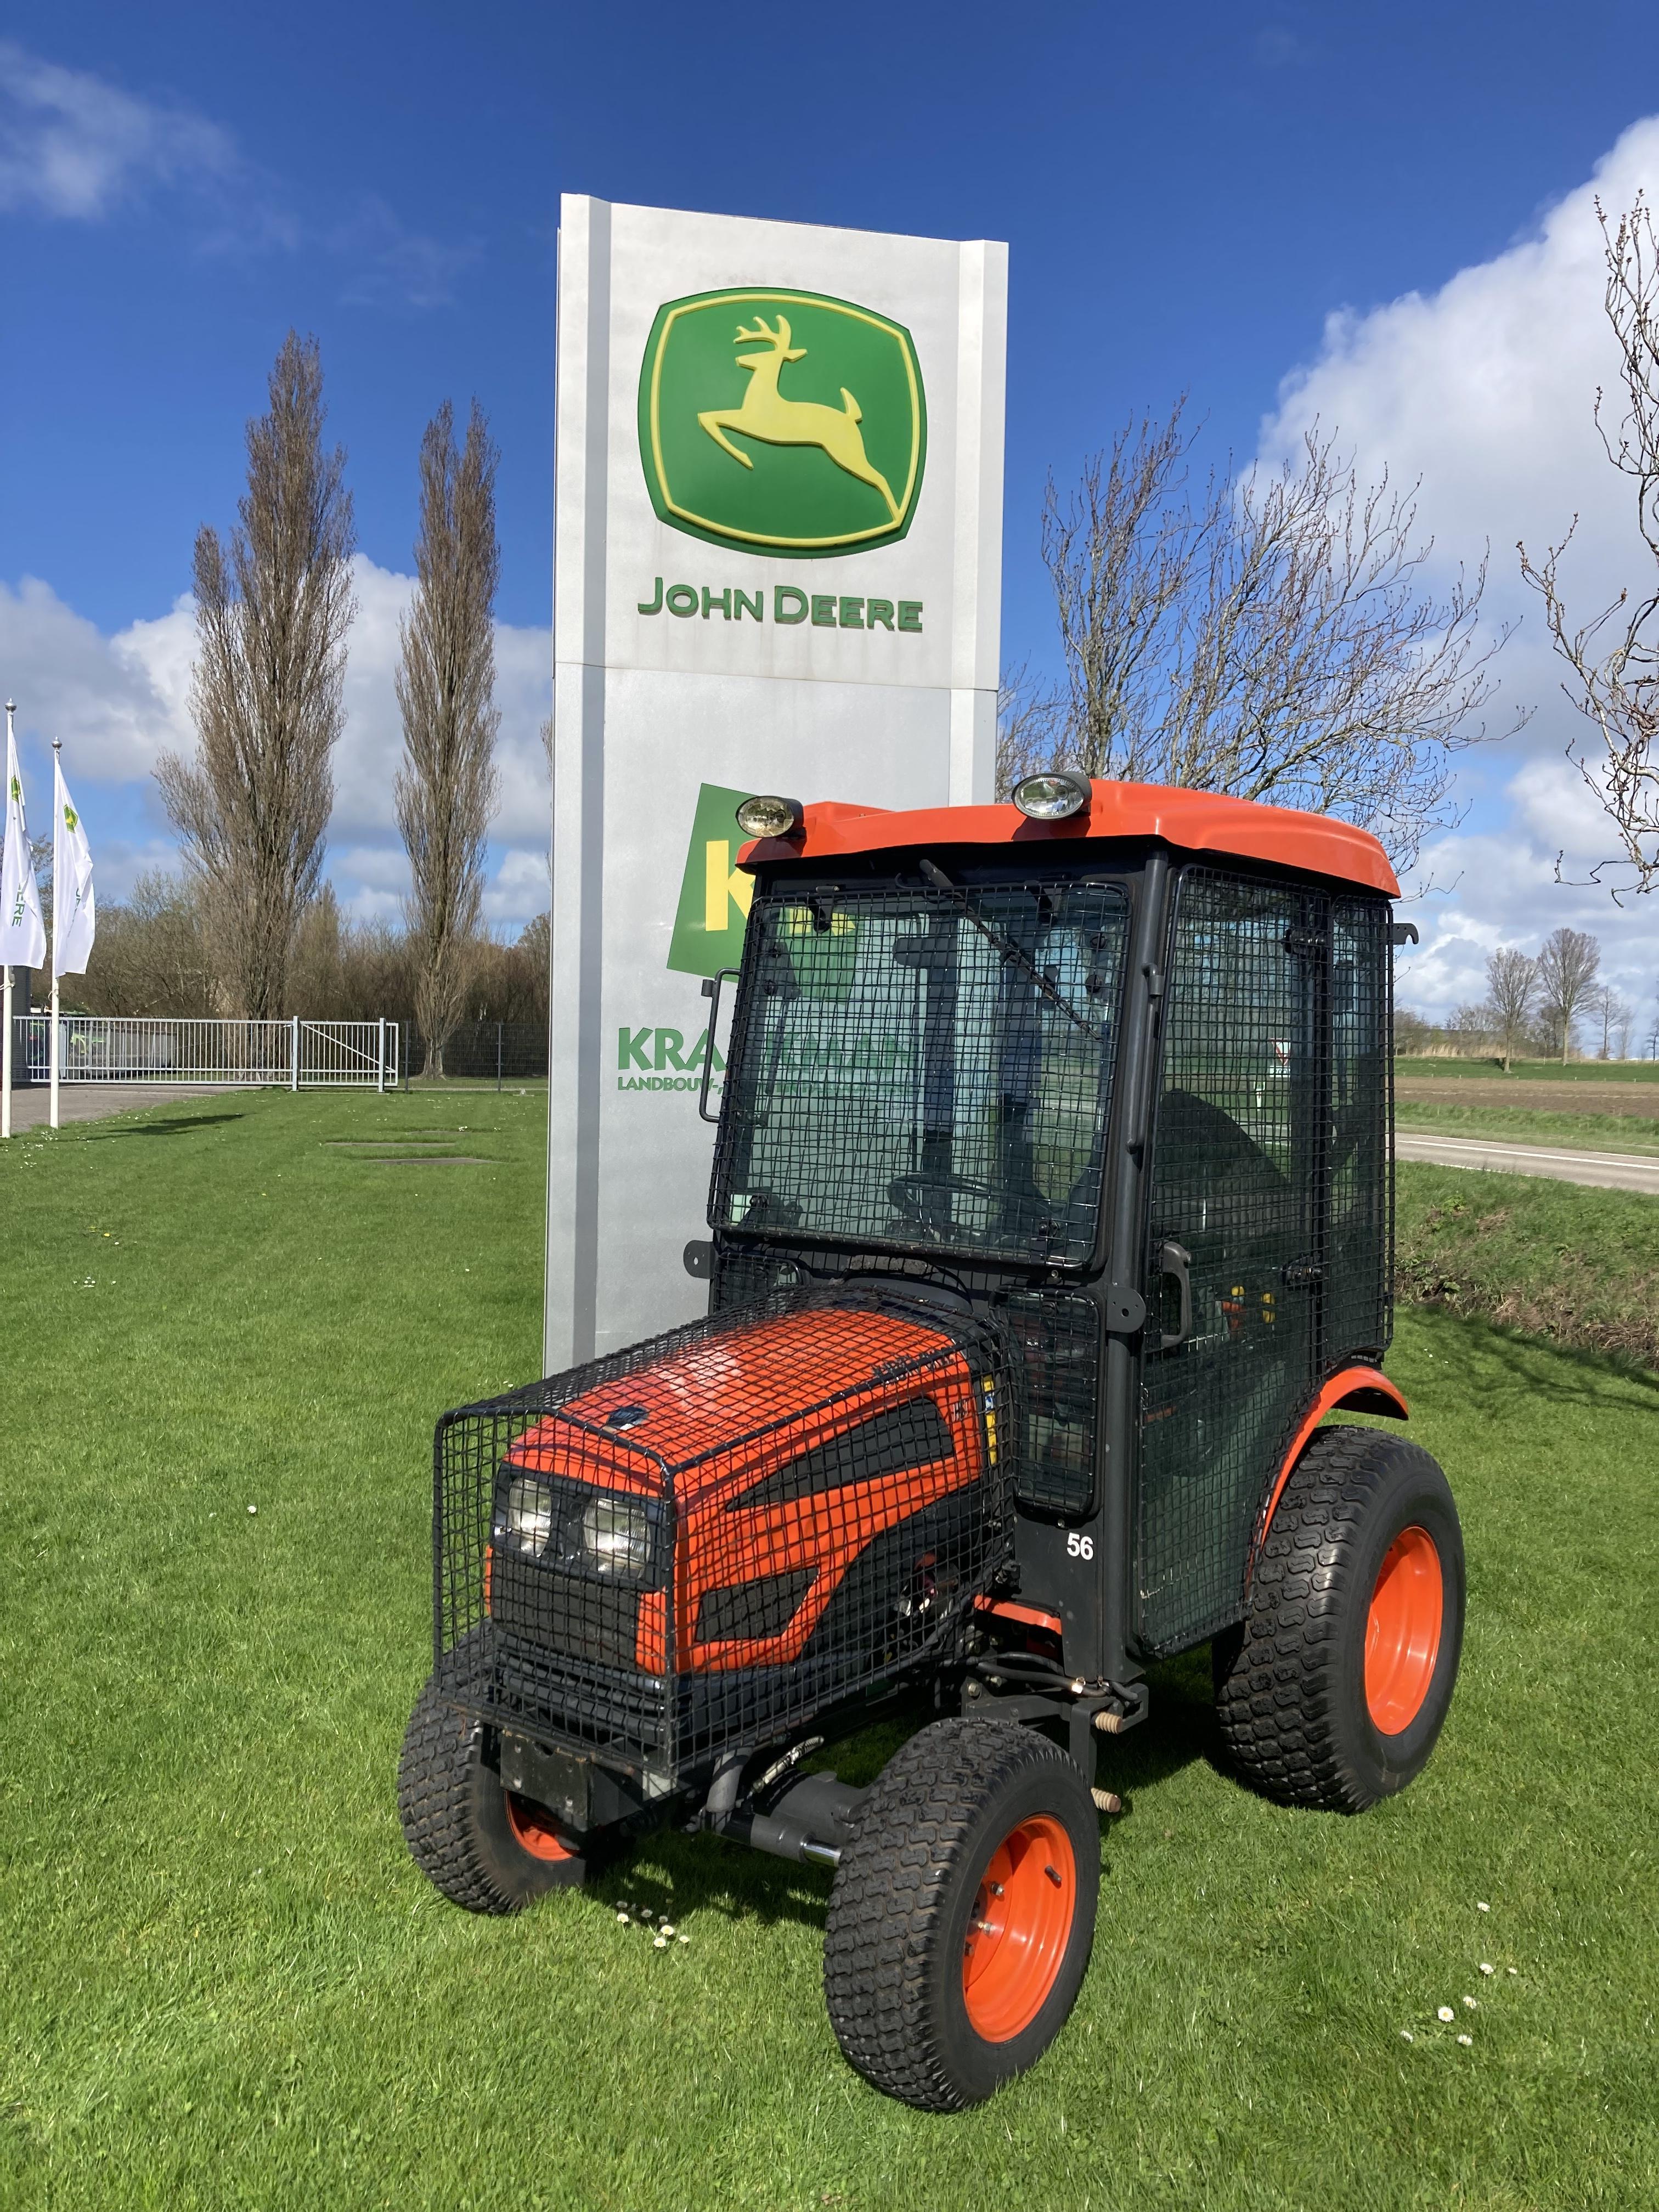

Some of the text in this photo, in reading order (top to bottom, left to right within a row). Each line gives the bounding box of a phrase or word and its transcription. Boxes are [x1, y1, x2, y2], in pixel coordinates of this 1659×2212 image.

[638, 577, 922, 632] JOHN DEERE
[1067, 1532, 1093, 1560] 56
